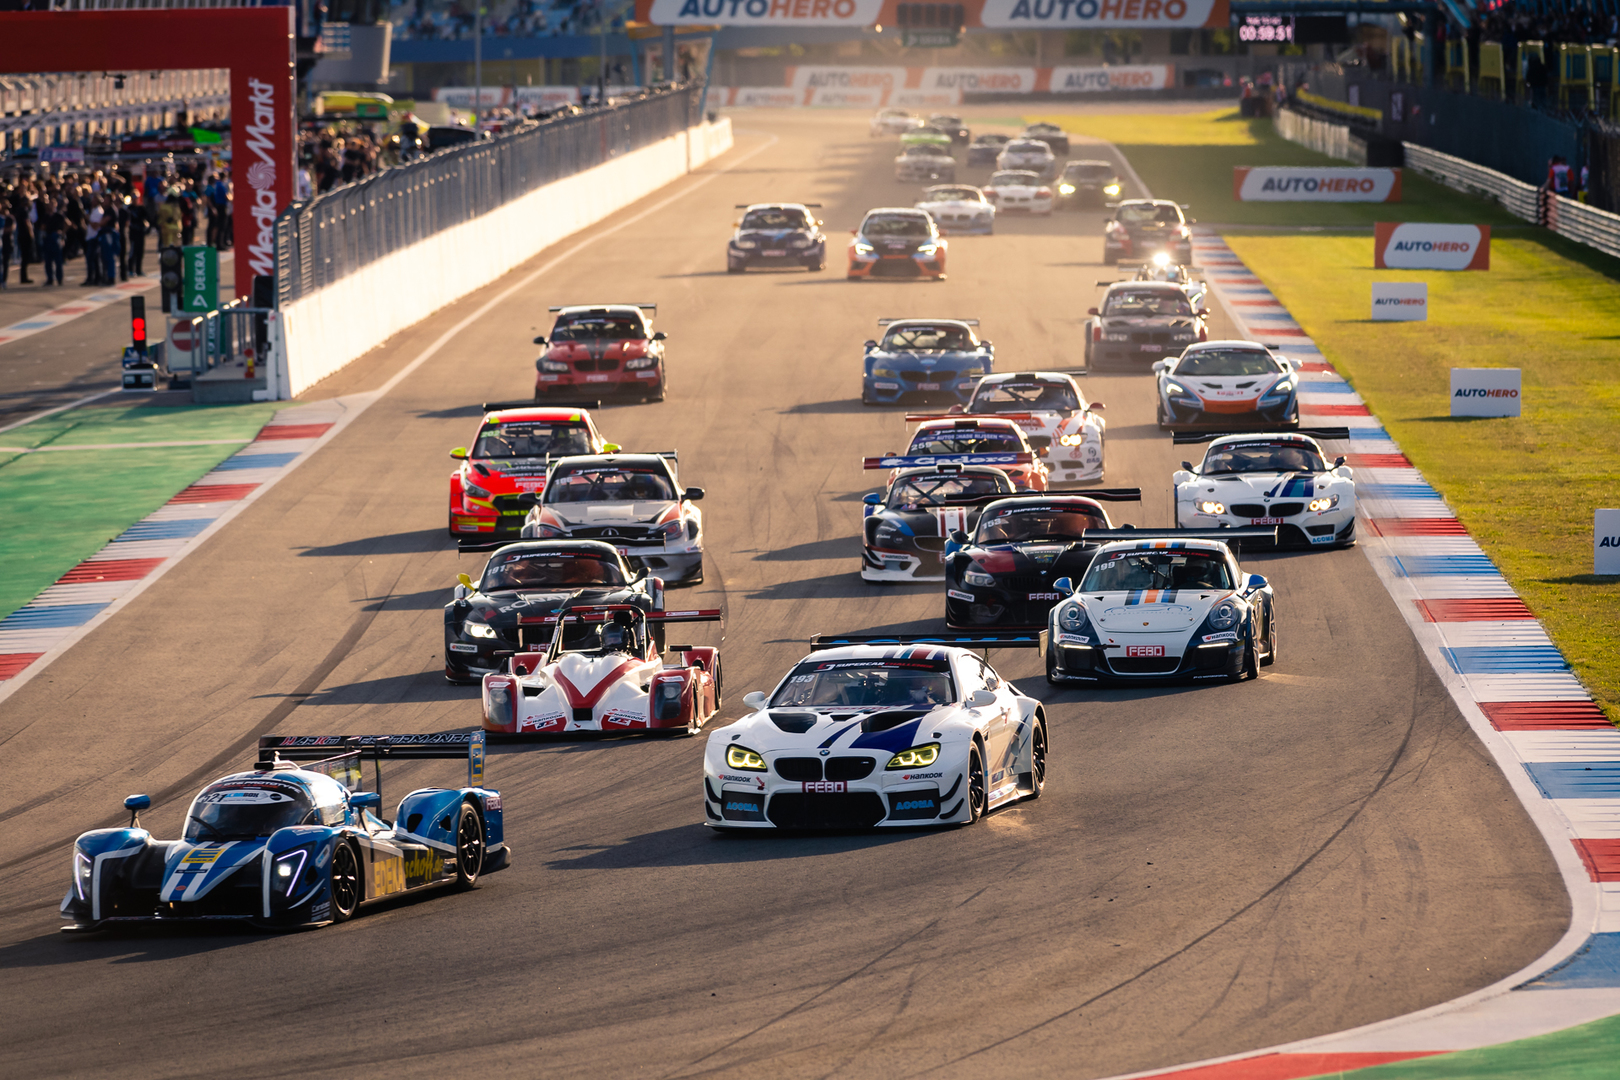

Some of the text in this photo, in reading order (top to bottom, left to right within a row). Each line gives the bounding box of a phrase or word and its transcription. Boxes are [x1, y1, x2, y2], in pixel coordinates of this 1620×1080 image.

[679, 0, 856, 18] AUTOHERO
[1009, 0, 1187, 20] AUTOHERO
[808, 72, 894, 88] AUTOHERO
[936, 73, 1022, 89] AUTOHERO
[1065, 71, 1154, 88] AUTOHERO
[1261, 177, 1375, 193] AUTOHERO
[1394, 240, 1471, 253] AUTOHERO
[194, 251, 206, 291] DEKRA
[1374, 297, 1425, 306] AUTOHERO
[1454, 388, 1519, 398] AUTOHERO
[911, 441, 932, 451] 259
[914, 455, 1014, 465] Gadero
[1312, 535, 1334, 543] ACOMA
[486, 565, 506, 576] 191
[1093, 561, 1116, 573] 199
[1129, 646, 1163, 656] FEBO
[789, 674, 815, 684] 193
[806, 781, 845, 793] FEBO
[725, 801, 759, 812] ACOMA
[895, 799, 935, 811] ACOMA
